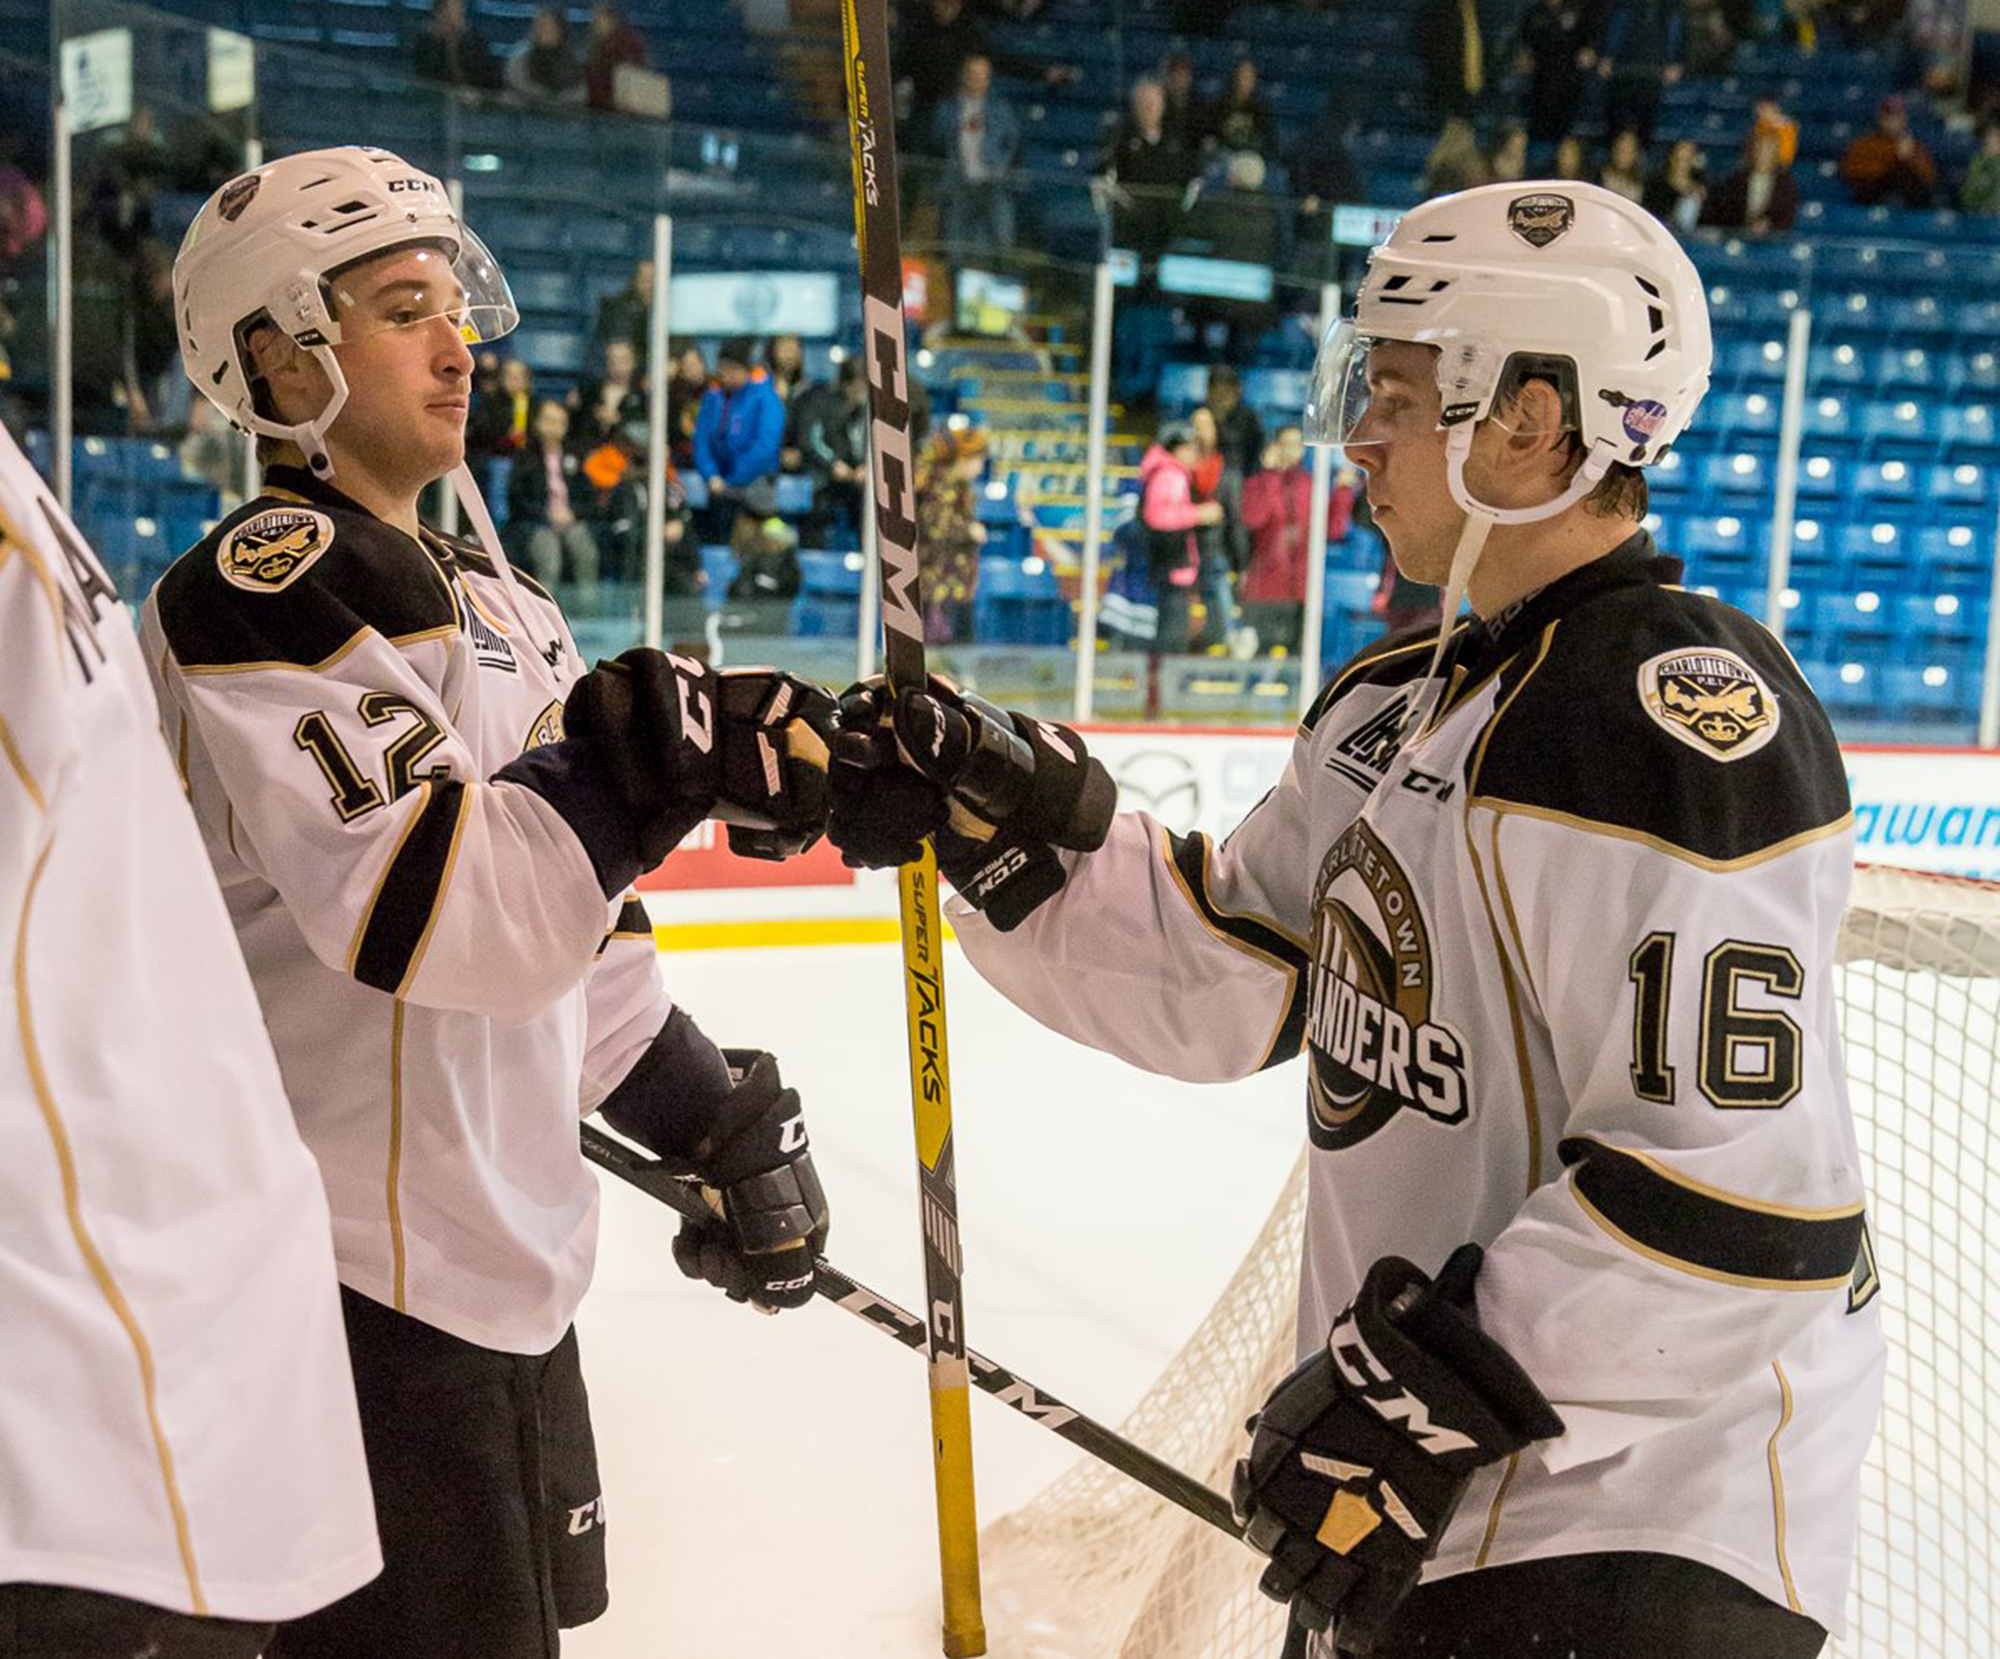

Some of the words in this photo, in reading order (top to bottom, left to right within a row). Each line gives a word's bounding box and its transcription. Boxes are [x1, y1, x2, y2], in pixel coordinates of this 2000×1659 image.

[865, 294, 923, 643] CCM
[1659, 656, 1754, 683] CHARLOTTETOWN
[293, 691, 451, 824] 12
[912, 870, 930, 963] SUPER
[978, 851, 1028, 897] CCM
[907, 958, 946, 1106] TACKS
[1629, 931, 1804, 1109] 16
